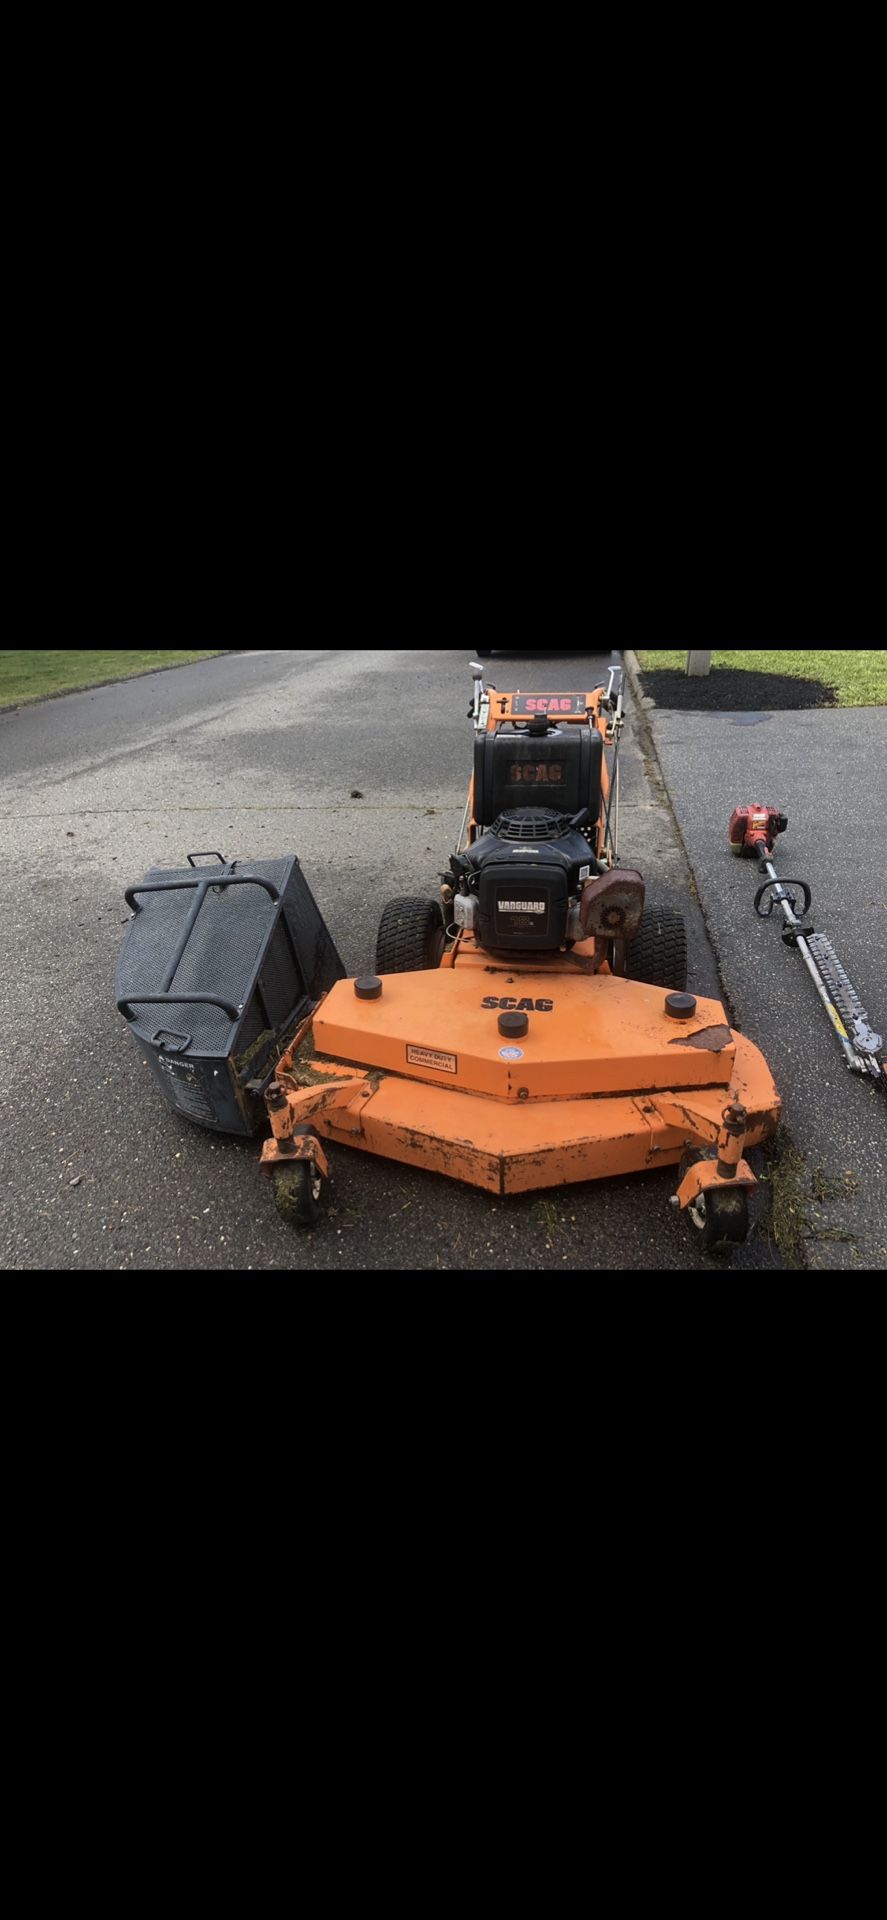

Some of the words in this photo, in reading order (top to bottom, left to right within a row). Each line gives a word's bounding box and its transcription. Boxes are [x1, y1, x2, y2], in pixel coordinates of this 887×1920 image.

[525, 698, 571, 711] SCAG
[511, 764, 561, 782] SCAG
[498, 901, 545, 911] VANGUARD
[481, 996, 553, 1011] SCAG
[165, 1058, 194, 1068] DANGER
[410, 1055, 453, 1070] COMMERCIAL
